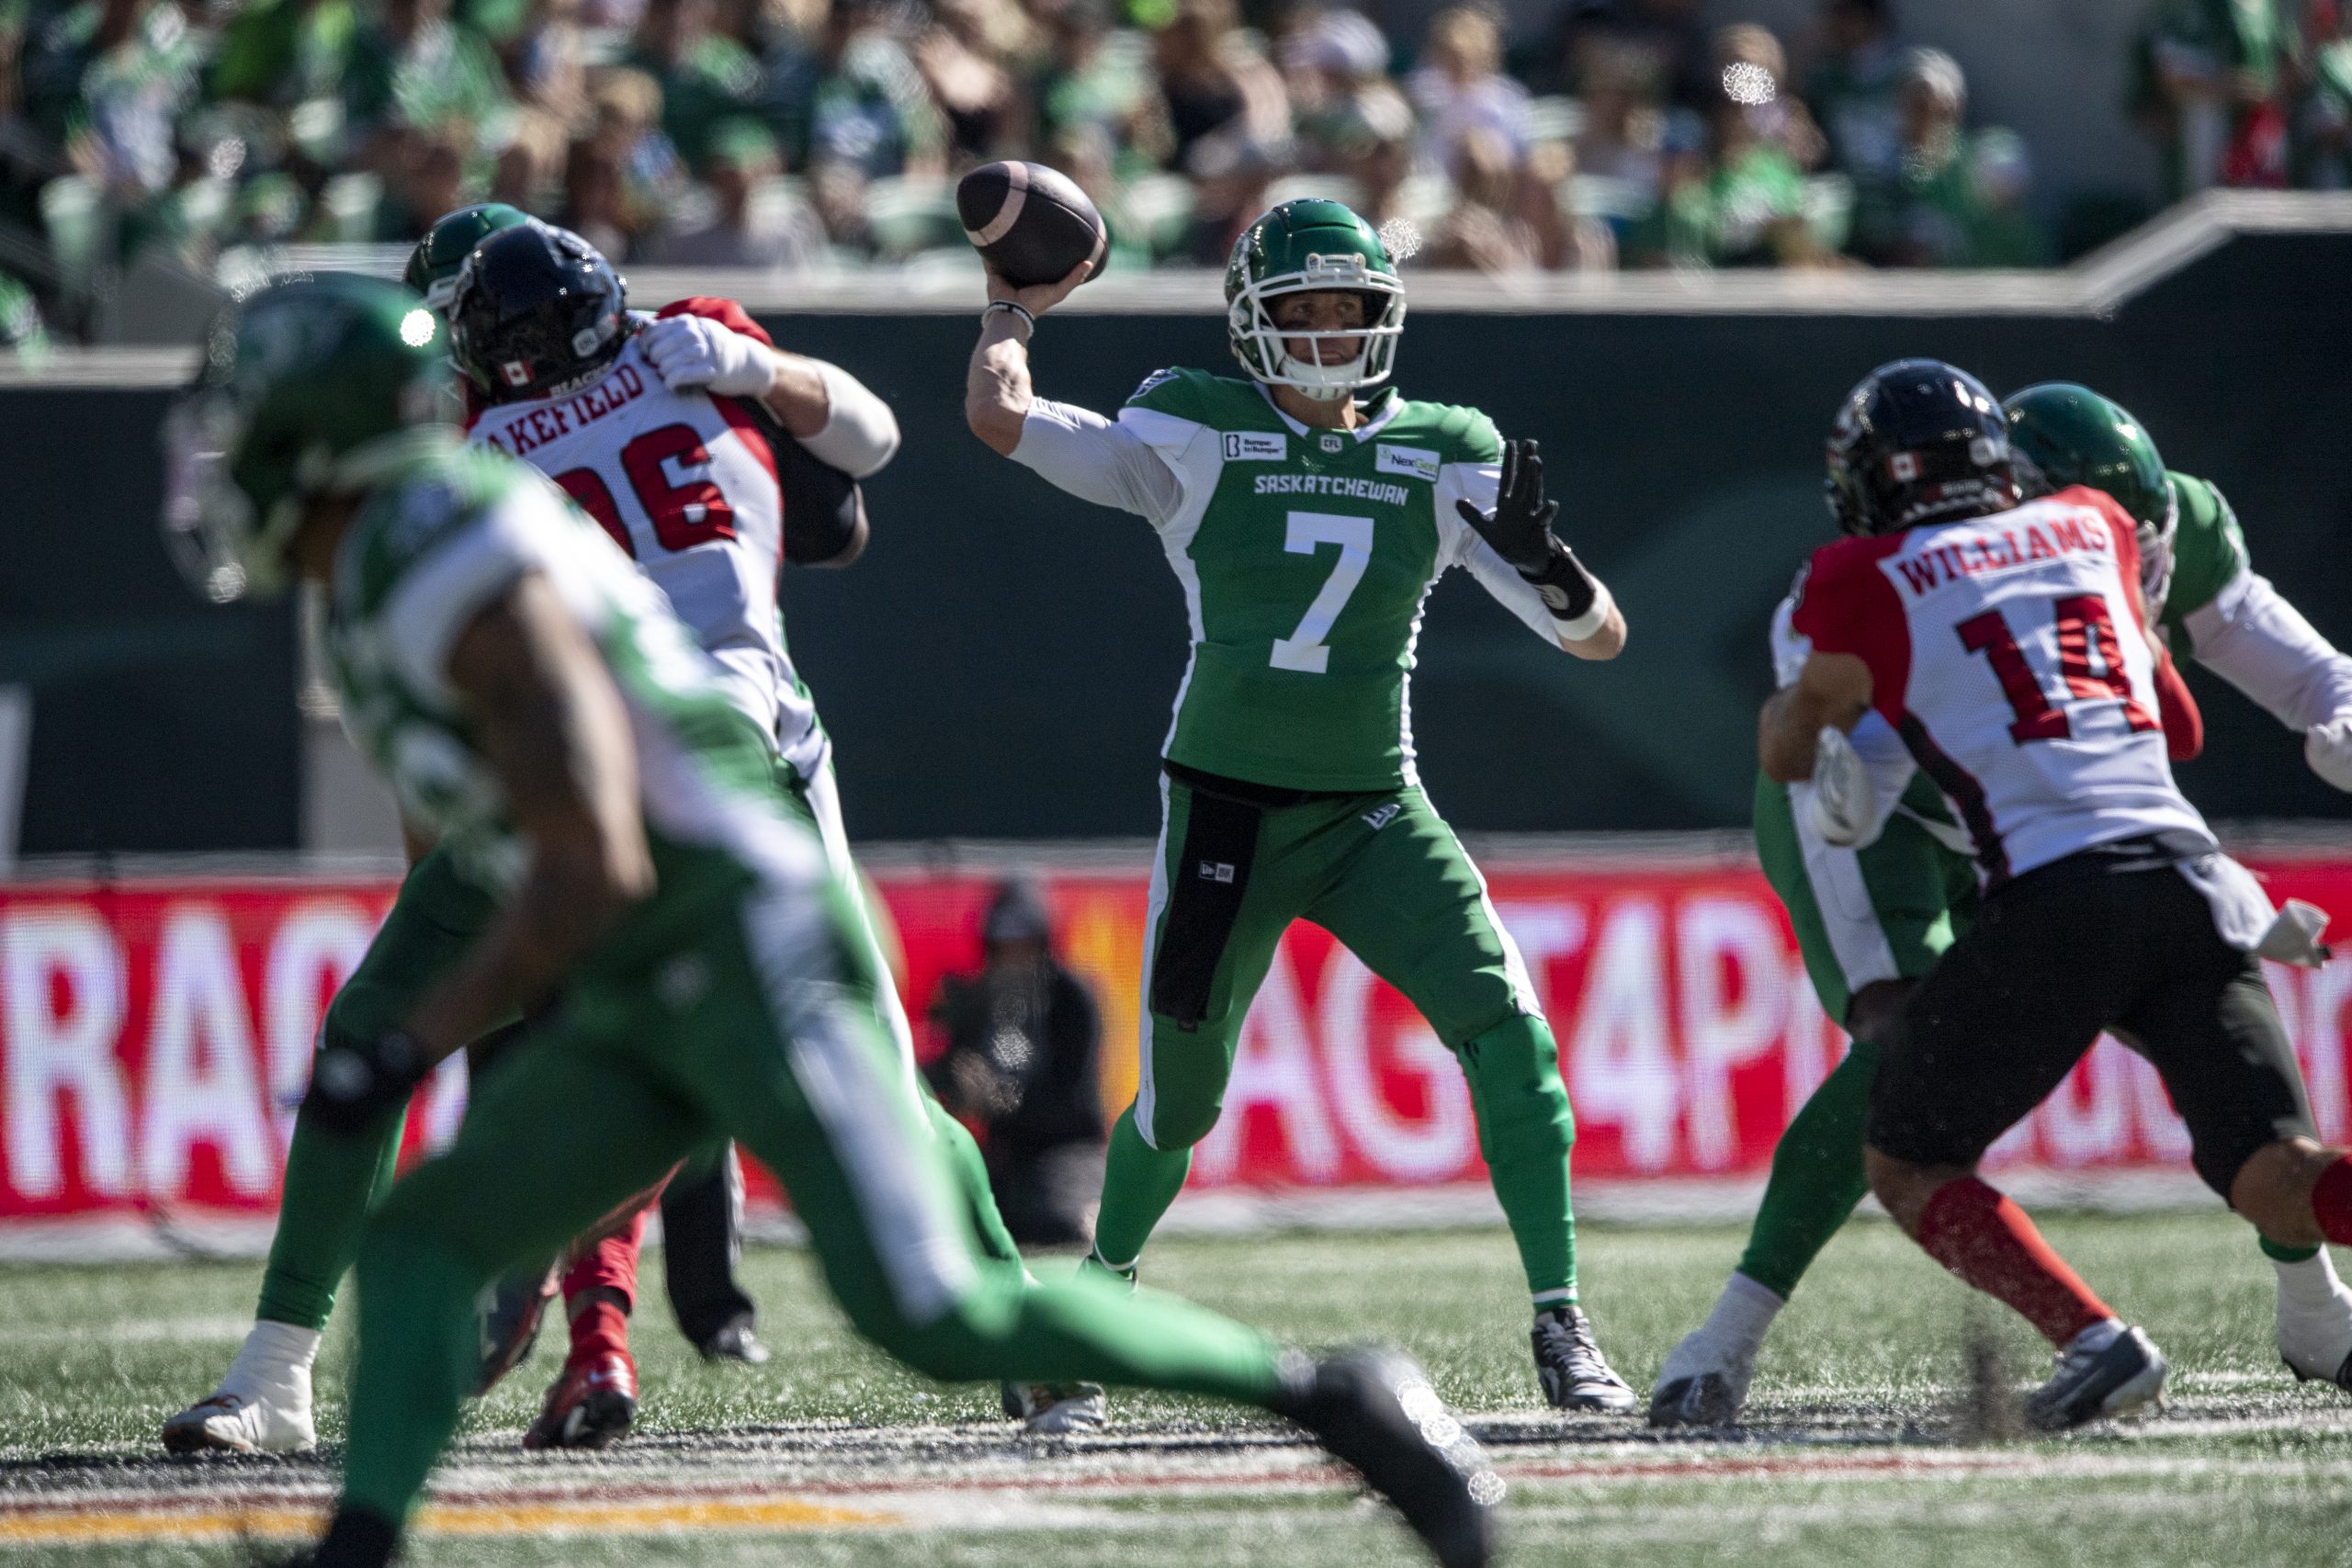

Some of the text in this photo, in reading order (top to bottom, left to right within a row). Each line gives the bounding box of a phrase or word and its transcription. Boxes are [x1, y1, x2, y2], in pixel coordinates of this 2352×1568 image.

[1254, 474, 1409, 507] SASKATCHEWAN
[1269, 510, 1374, 674] 7
[1896, 514, 2109, 598] WILLIAMS
[1954, 593, 2163, 746] 14
